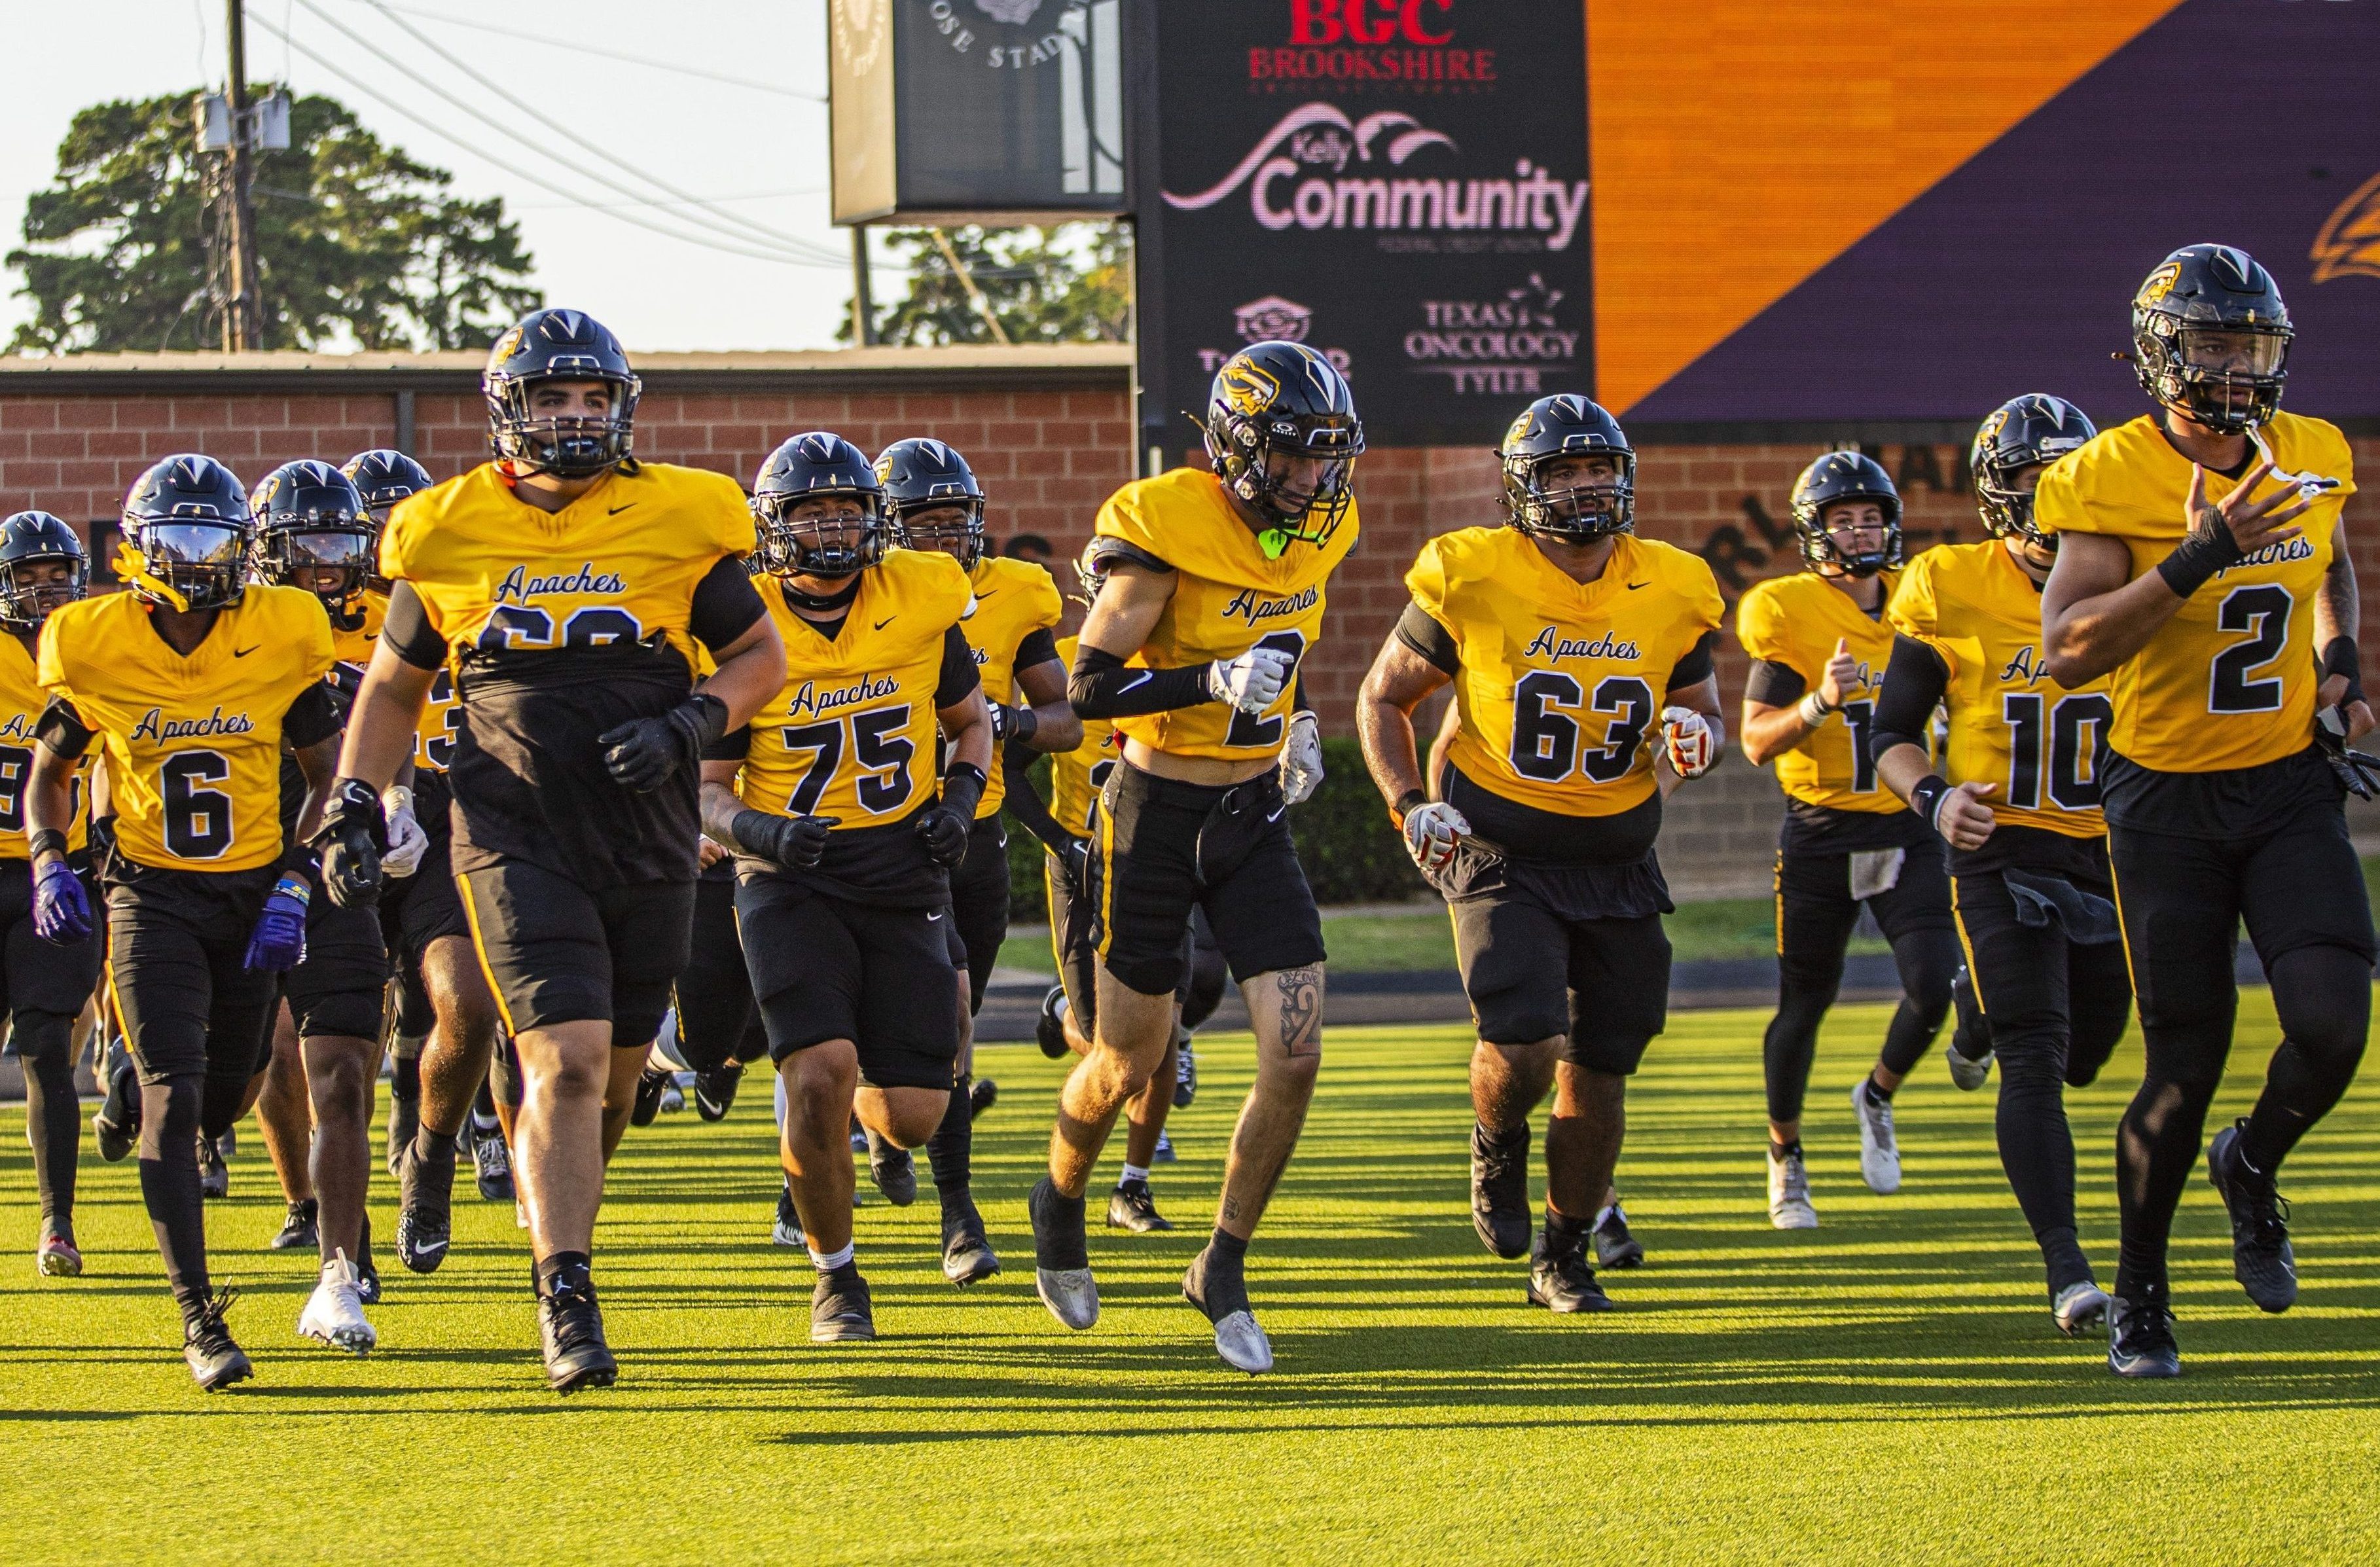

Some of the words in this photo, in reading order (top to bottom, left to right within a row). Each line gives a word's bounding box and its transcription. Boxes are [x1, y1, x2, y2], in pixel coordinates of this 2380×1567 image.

[930, 1, 976, 53] OSE
[1289, 0, 1455, 45] BGC
[1249, 47, 1499, 80] BROOKSHIRE
[1291, 130, 1353, 173] Kelly
[1250, 156, 1591, 251] Community
[1424, 301, 1514, 327] TEXAS
[1403, 331, 1579, 359] ONCOLOGY
[1449, 368, 1542, 394] TYLER
[494, 562, 626, 605] Apaches
[1524, 626, 1641, 664] Apaches
[2207, 582, 2294, 714] 2
[787, 673, 899, 719] Apaches
[131, 706, 255, 747] Apaches
[1509, 670, 1655, 784] 63
[782, 702, 916, 815] 75
[2003, 693, 2112, 811] 10
[161, 749, 234, 859] 6
